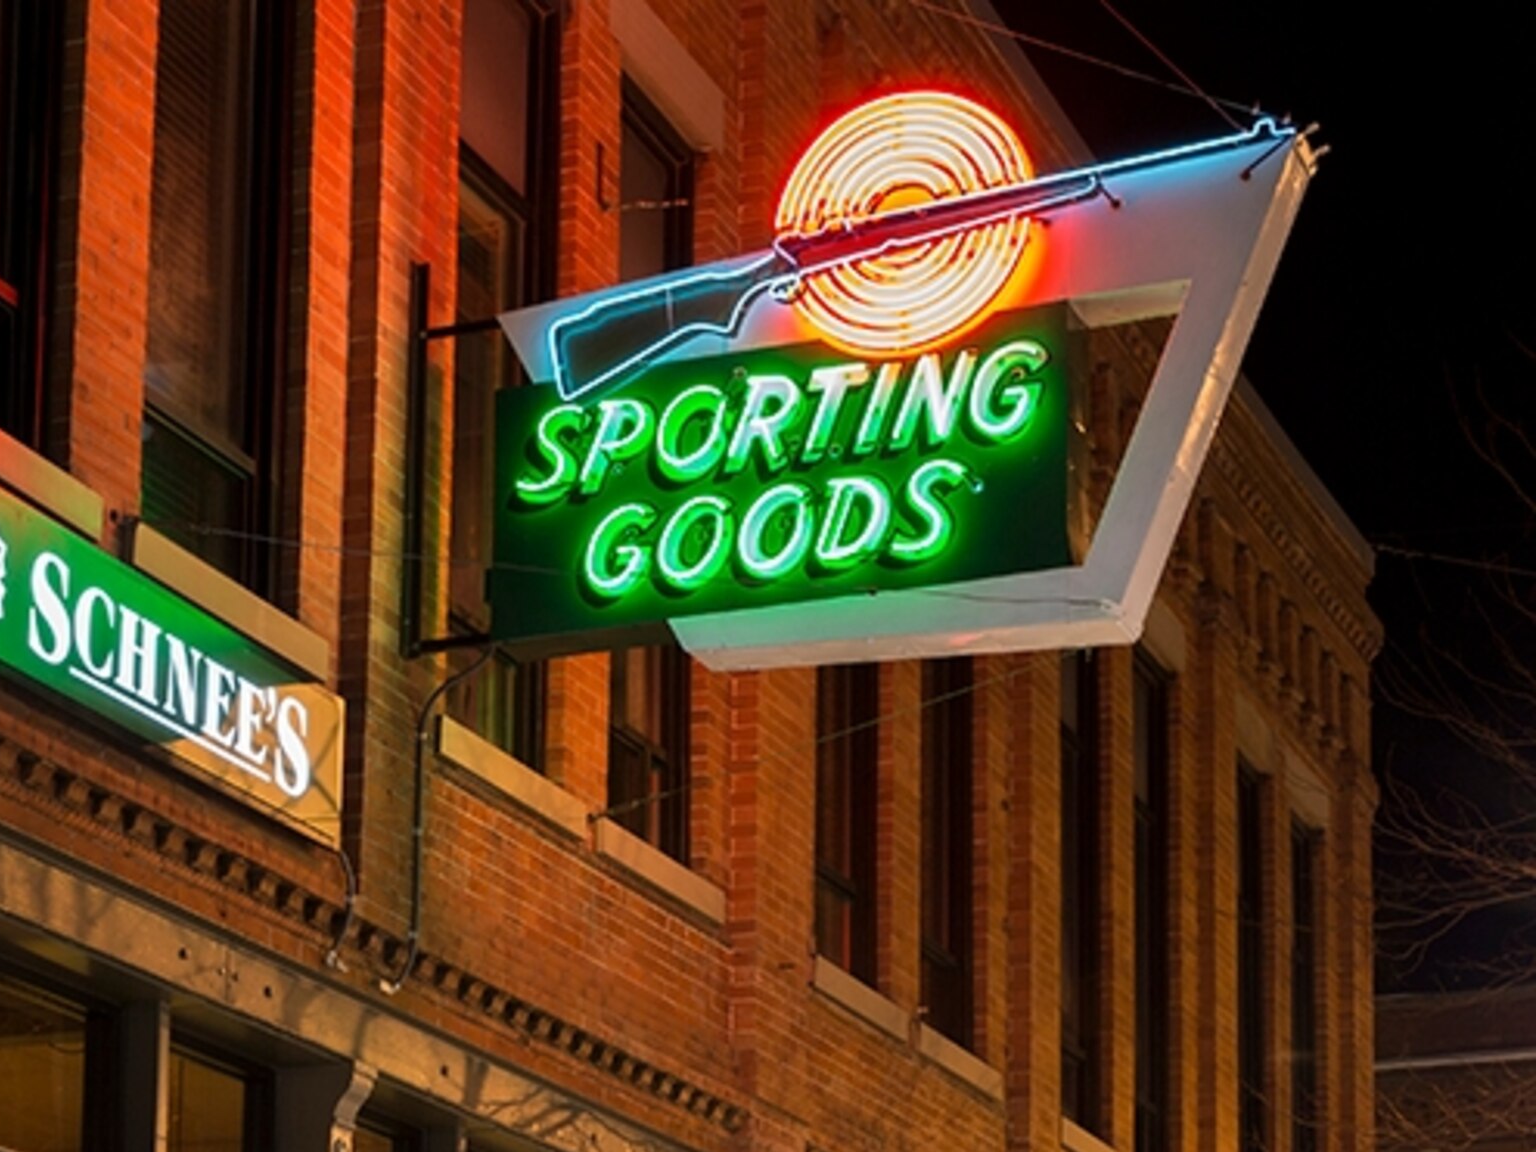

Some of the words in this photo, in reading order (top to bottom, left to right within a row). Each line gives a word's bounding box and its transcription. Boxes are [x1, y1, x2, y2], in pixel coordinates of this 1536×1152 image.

[515, 340, 1049, 502] SPORTING
[581, 458, 966, 596] GOODS
[28, 552, 310, 797] SCHNEE'S
